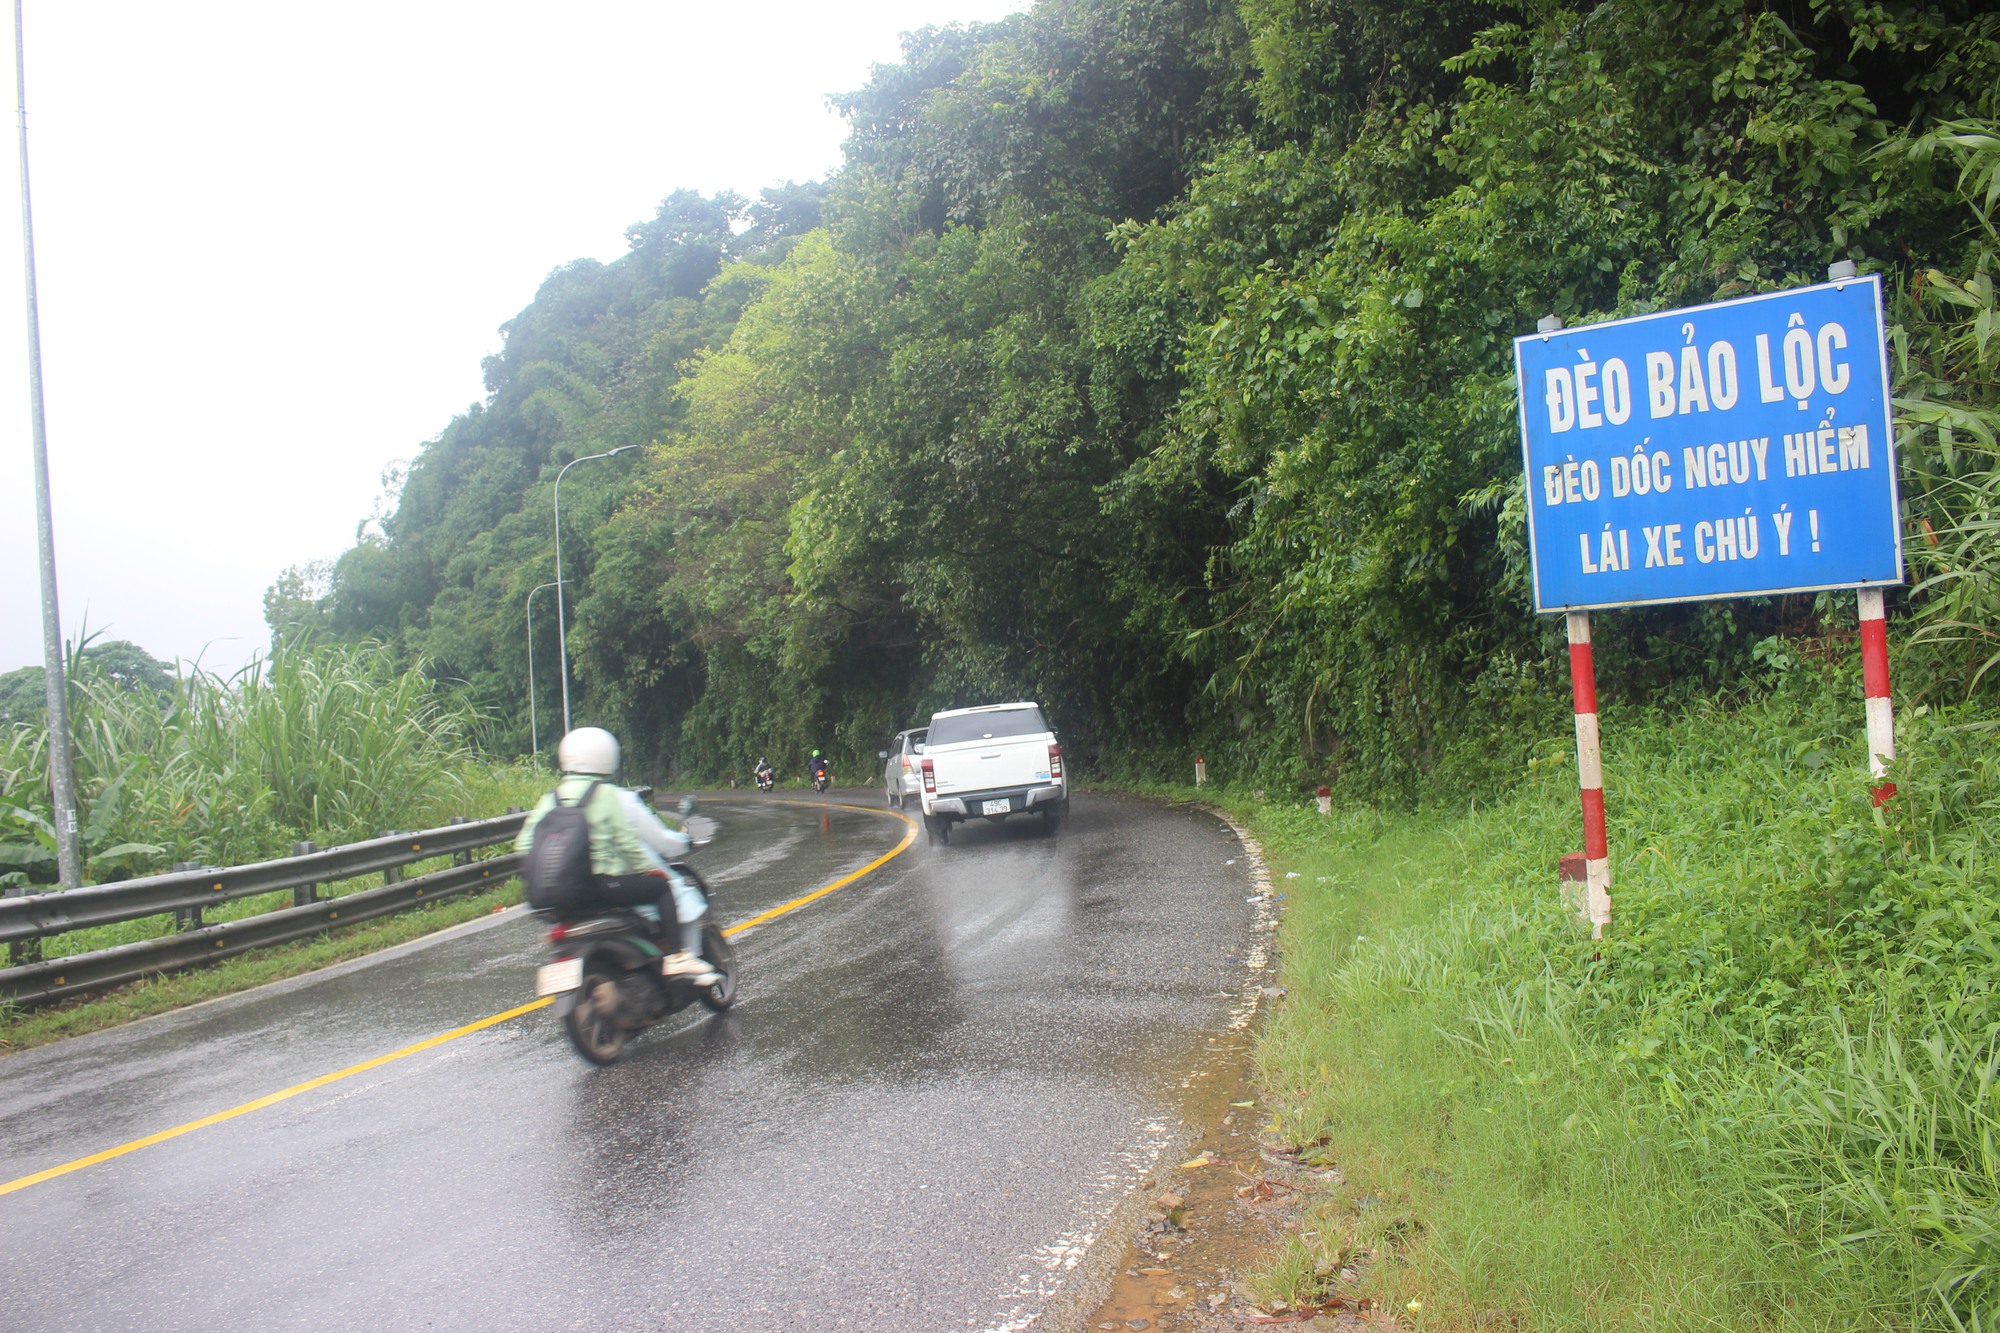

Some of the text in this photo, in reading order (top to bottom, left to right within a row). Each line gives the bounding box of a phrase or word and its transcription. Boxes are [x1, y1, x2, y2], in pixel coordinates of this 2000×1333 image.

[1546, 312, 1850, 434] ĐÈO BẢO LỘC
[1543, 407, 1870, 506] ĐÈO DỐC NGUY HIỂM
[1580, 522, 1630, 574] LÁI
[1643, 524, 1684, 569] XE
[1694, 506, 1759, 564] CHÚ
